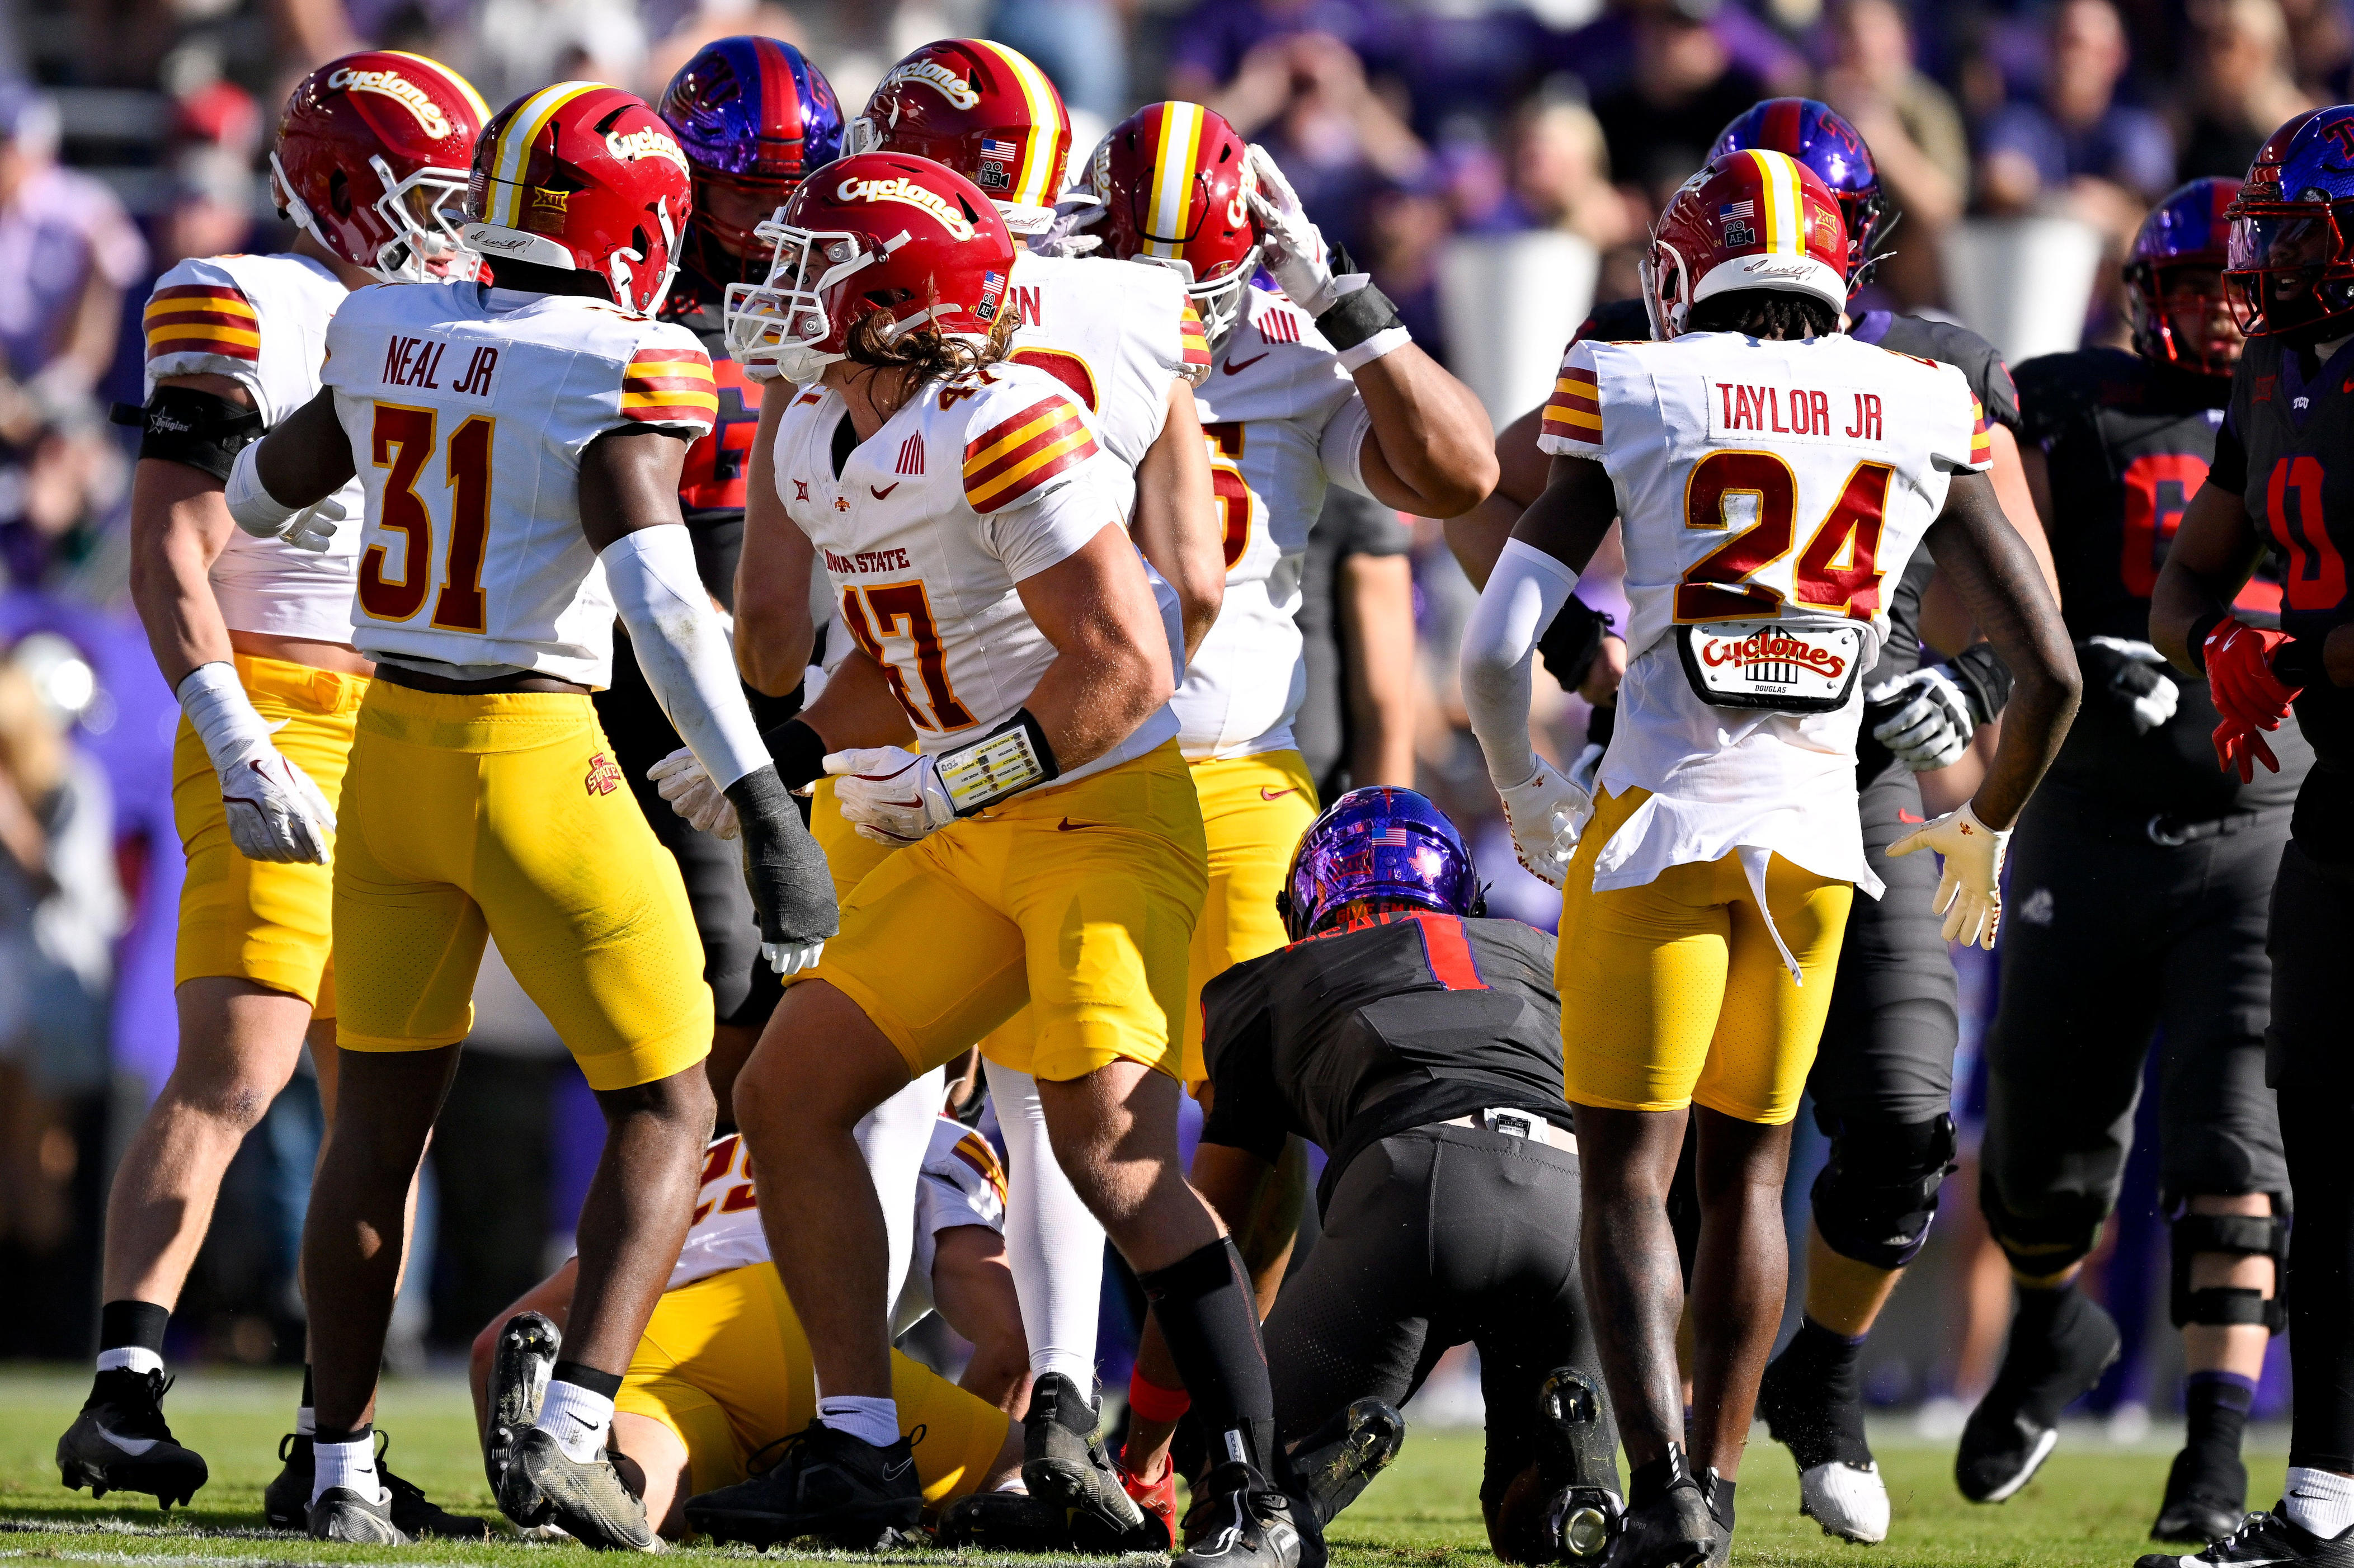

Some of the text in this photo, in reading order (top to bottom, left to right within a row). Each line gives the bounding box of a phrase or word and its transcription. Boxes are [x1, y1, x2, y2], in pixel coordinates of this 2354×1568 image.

[328, 67, 451, 140] Cyclones
[606, 125, 690, 182] Cyclon
[983, 173, 999, 184] AE
[837, 177, 976, 241] Cyclones
[1729, 233, 1744, 244] AE
[968, 305, 976, 313] 47
[980, 305, 990, 316] AE
[382, 335, 498, 397] NEAL JR
[1716, 383, 1882, 440] TAYLOR JR
[2294, 396, 2309, 409] TCU
[156, 417, 189, 431] Douglas
[358, 401, 496, 634] 31
[1672, 449, 1896, 623] 24
[855, 548, 911, 573] STATE
[1702, 632, 1845, 679] Cyclones
[1755, 684, 1787, 694] DOUGLAS
[587, 764, 619, 791] STATE
